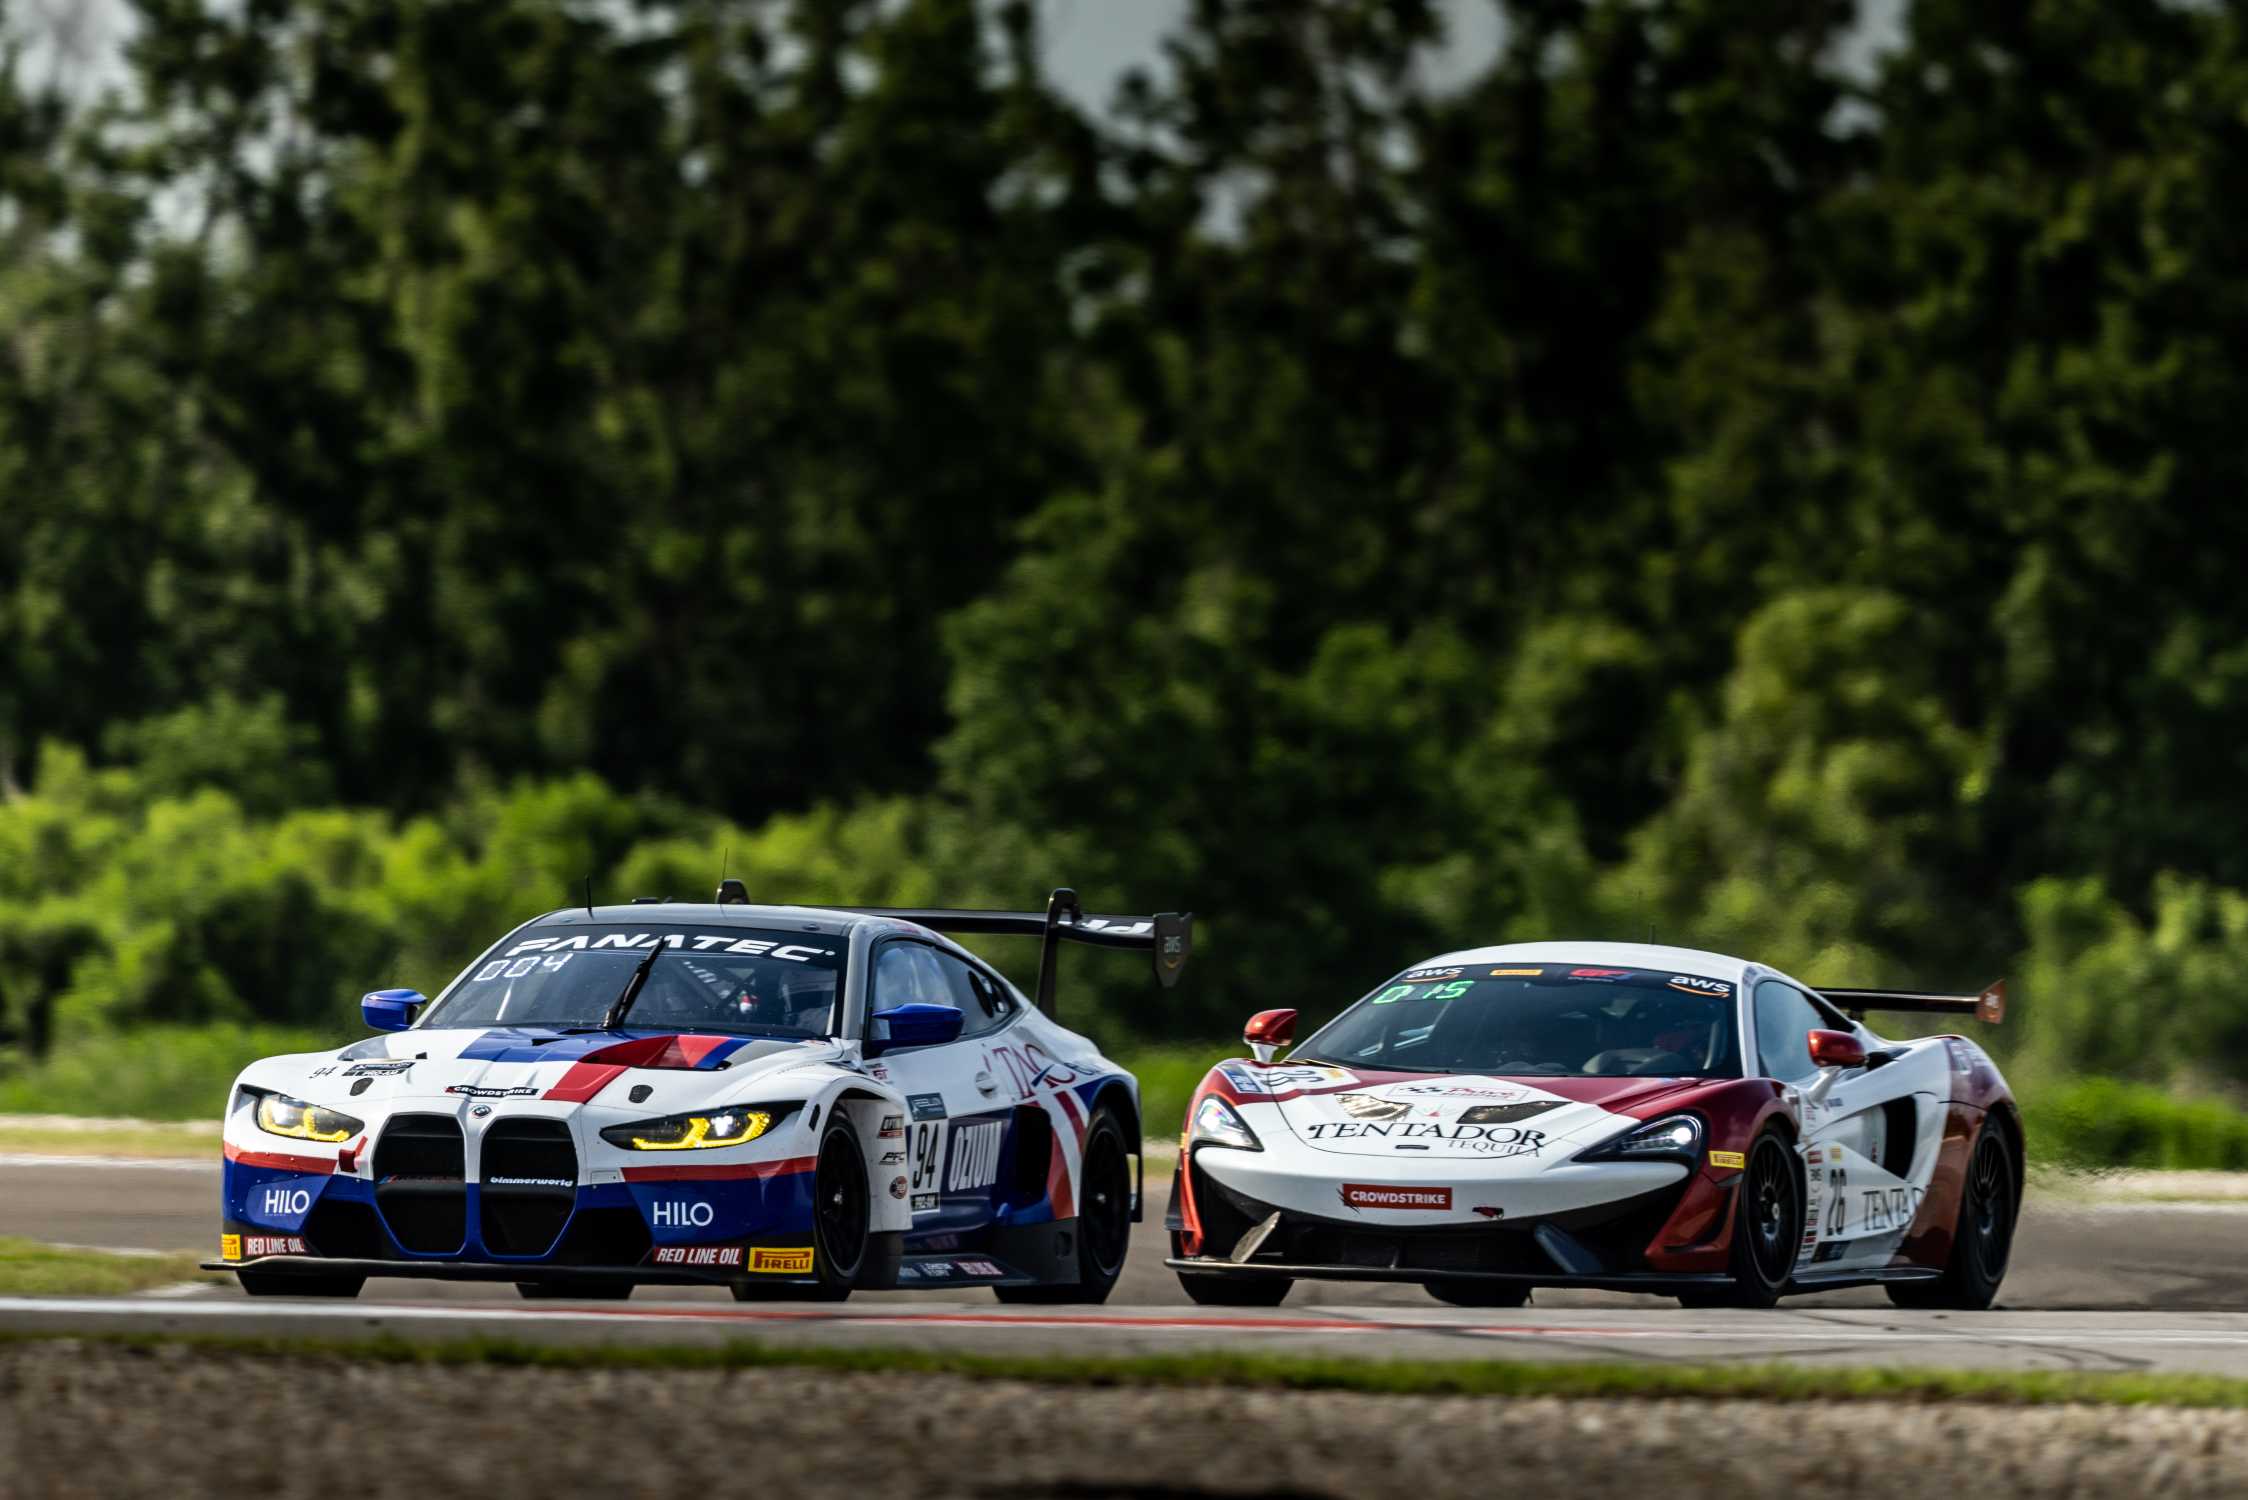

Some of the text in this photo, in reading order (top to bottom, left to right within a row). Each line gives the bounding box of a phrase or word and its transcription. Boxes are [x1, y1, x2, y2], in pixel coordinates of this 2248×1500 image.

[504, 933, 827, 962] FANATEC
[454, 1086, 533, 1097] CROWDSTRIKE
[1308, 1122, 1546, 1149] TENTADOR
[912, 1123, 940, 1190] 94
[1448, 1138, 1541, 1158] TEQUILA
[490, 1176, 574, 1188] bimmerworld
[265, 1189, 310, 1214] HILO
[1350, 1190, 1446, 1205] CROWDSTRIKE
[1826, 1167, 1848, 1237] 26
[653, 1201, 714, 1227] HILO
[247, 1237, 305, 1255] RED LINE OIL
[656, 1248, 740, 1265] RED LINE OIL
[753, 1250, 811, 1270] PIRELLI
